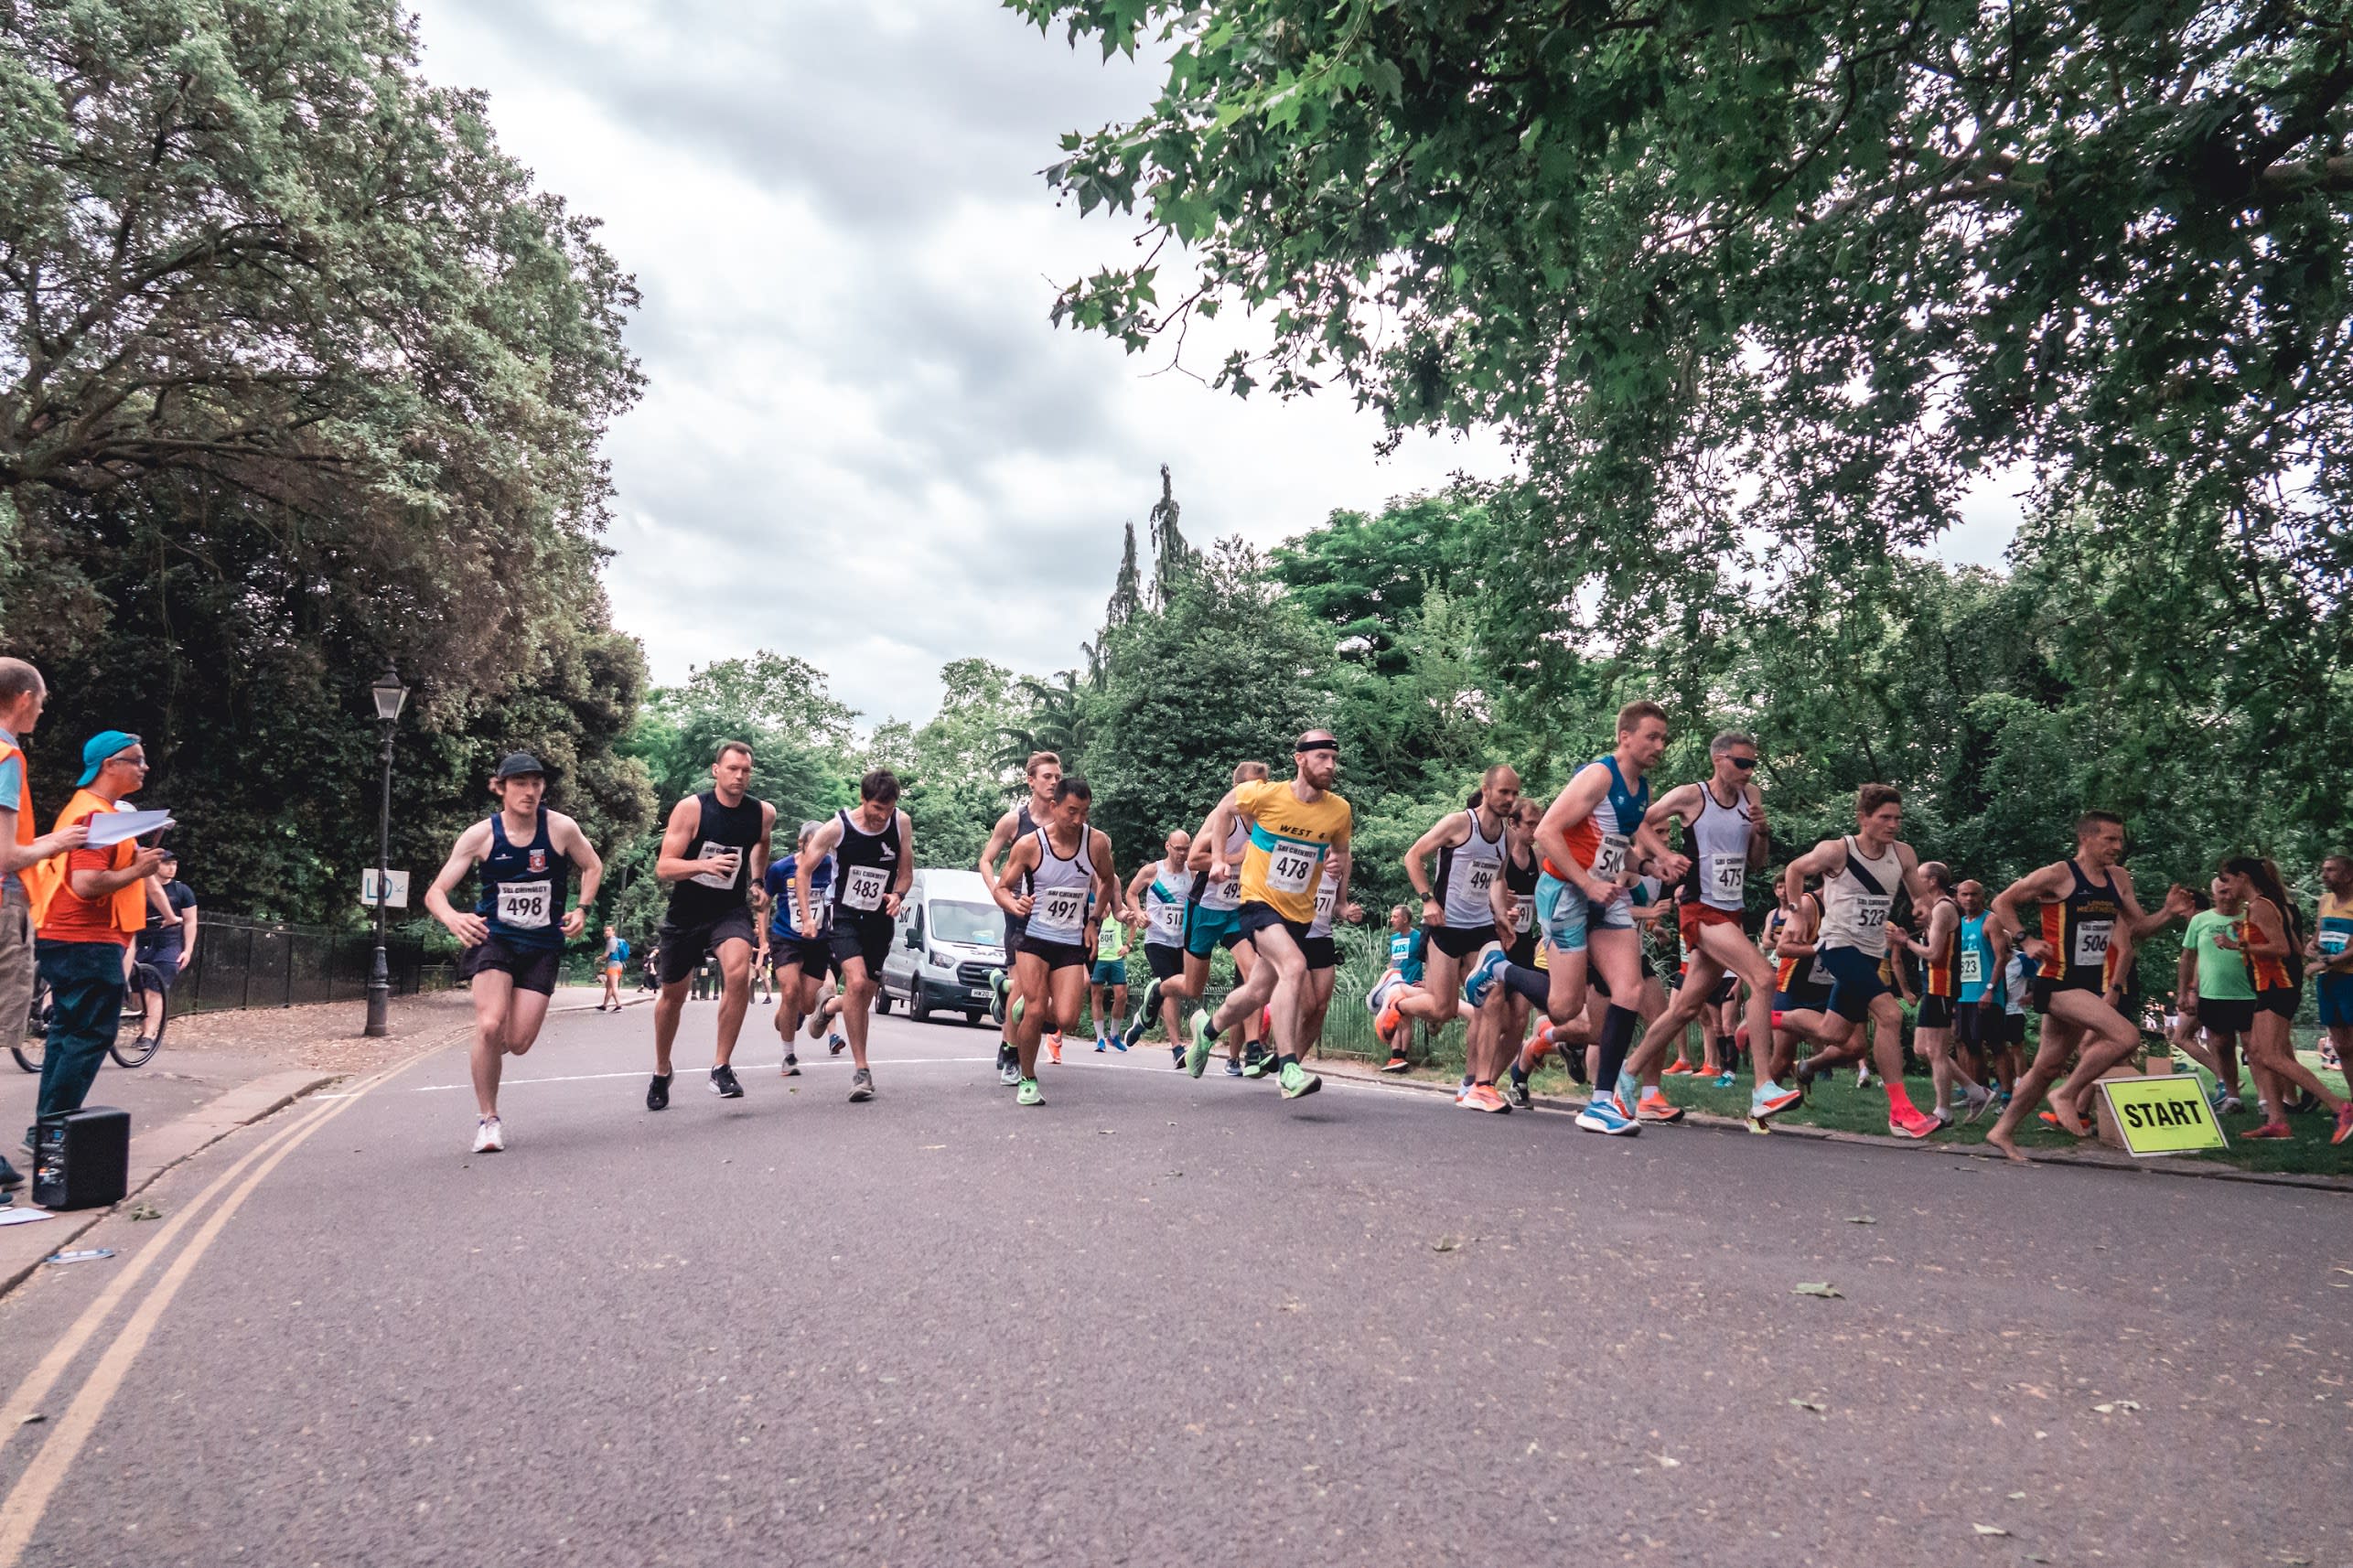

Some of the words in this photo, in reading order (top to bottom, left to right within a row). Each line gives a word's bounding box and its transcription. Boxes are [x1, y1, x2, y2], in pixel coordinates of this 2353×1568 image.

[1280, 824, 1312, 837] WEST
[1289, 847, 1316, 858] CHINMOY
[1276, 857, 1309, 880] 478
[1719, 868, 1742, 886] 475
[853, 879, 879, 898] 483
[1470, 872, 1493, 889] 496
[1223, 883, 1241, 898] 49
[506, 897, 542, 916] 498
[796, 908, 818, 923] 57
[1048, 900, 1078, 919] 492
[1858, 909, 1886, 927] 523
[1100, 933, 1113, 943] 804
[2081, 934, 2108, 952] 506
[2123, 1100, 2203, 1128] START
